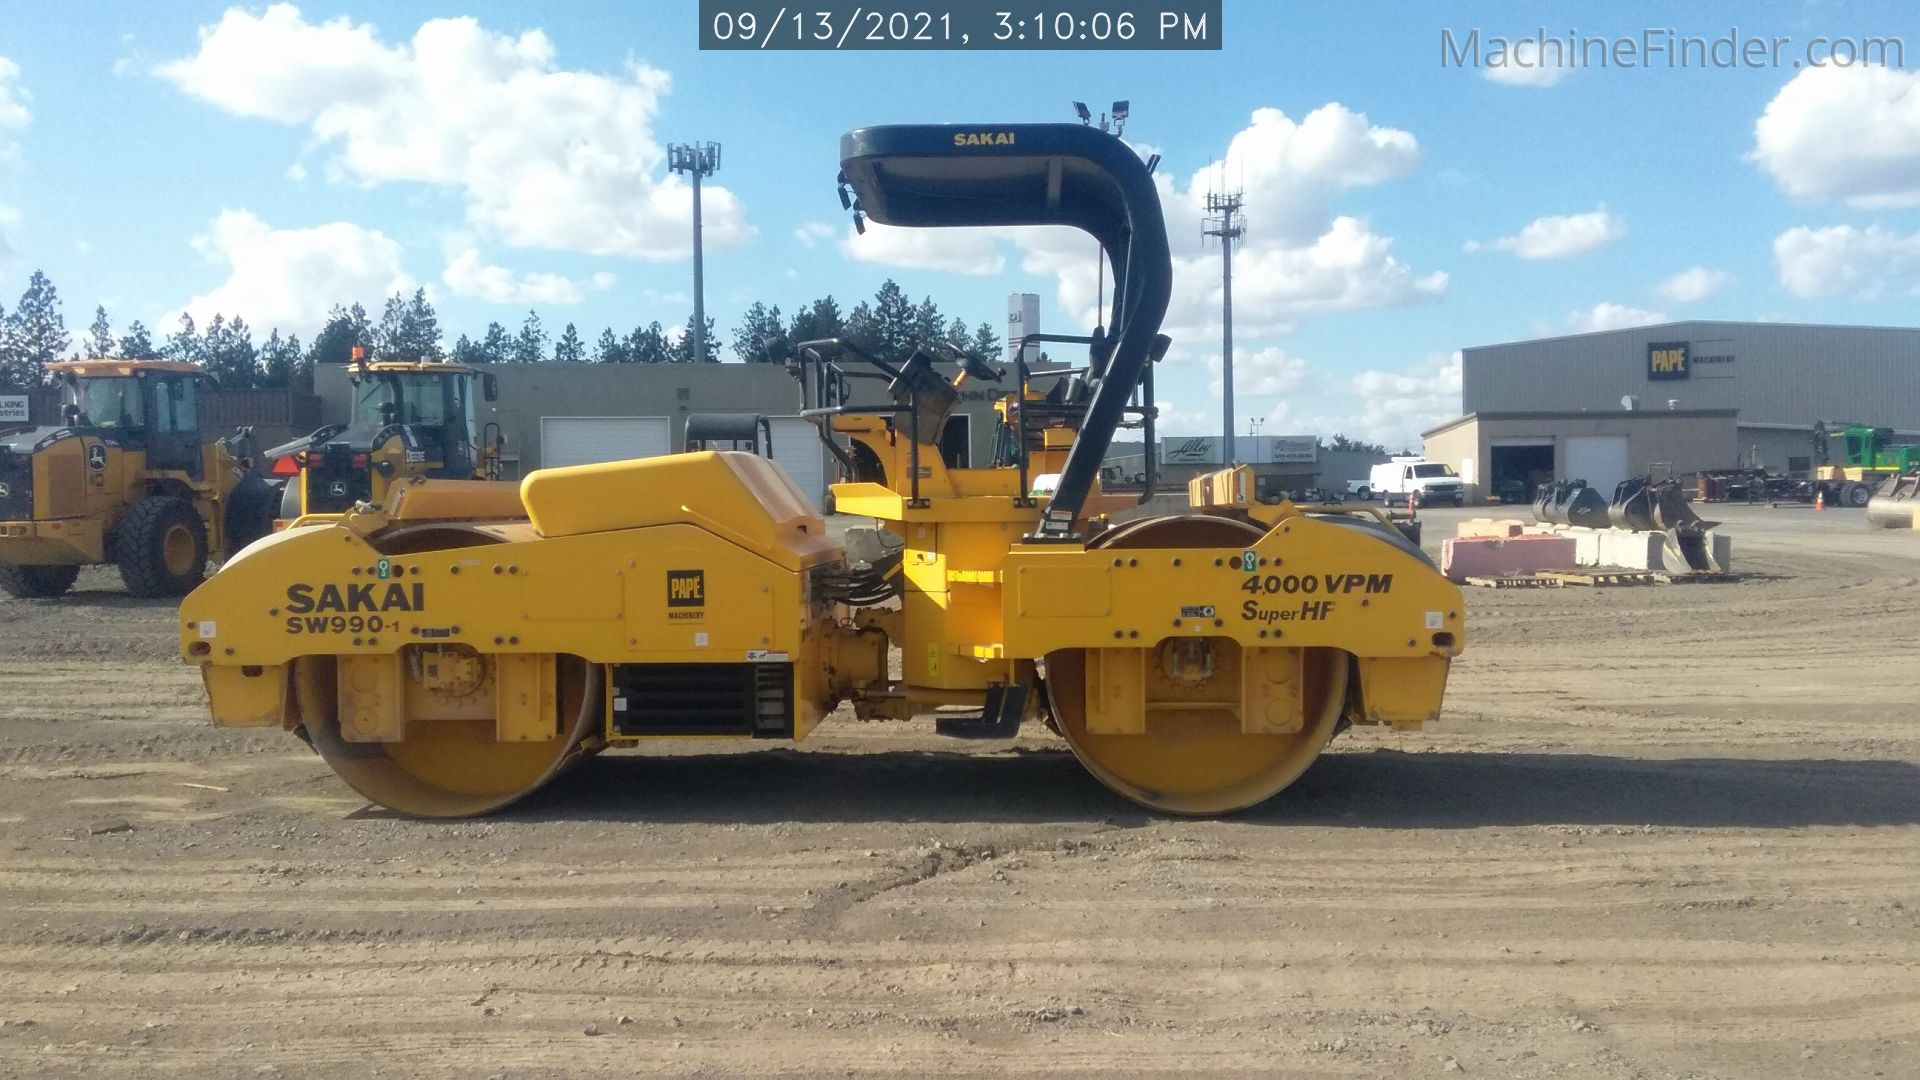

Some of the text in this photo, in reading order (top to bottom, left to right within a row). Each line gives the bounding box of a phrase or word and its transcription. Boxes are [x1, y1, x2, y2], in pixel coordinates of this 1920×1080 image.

[953, 132, 1015, 146] SAKAI
[1241, 574, 1394, 596] 4,000 VPM
[285, 582, 425, 614] SAKAI
[285, 615, 400, 635] SW990-1
[668, 611, 705, 620] MACHINERY
